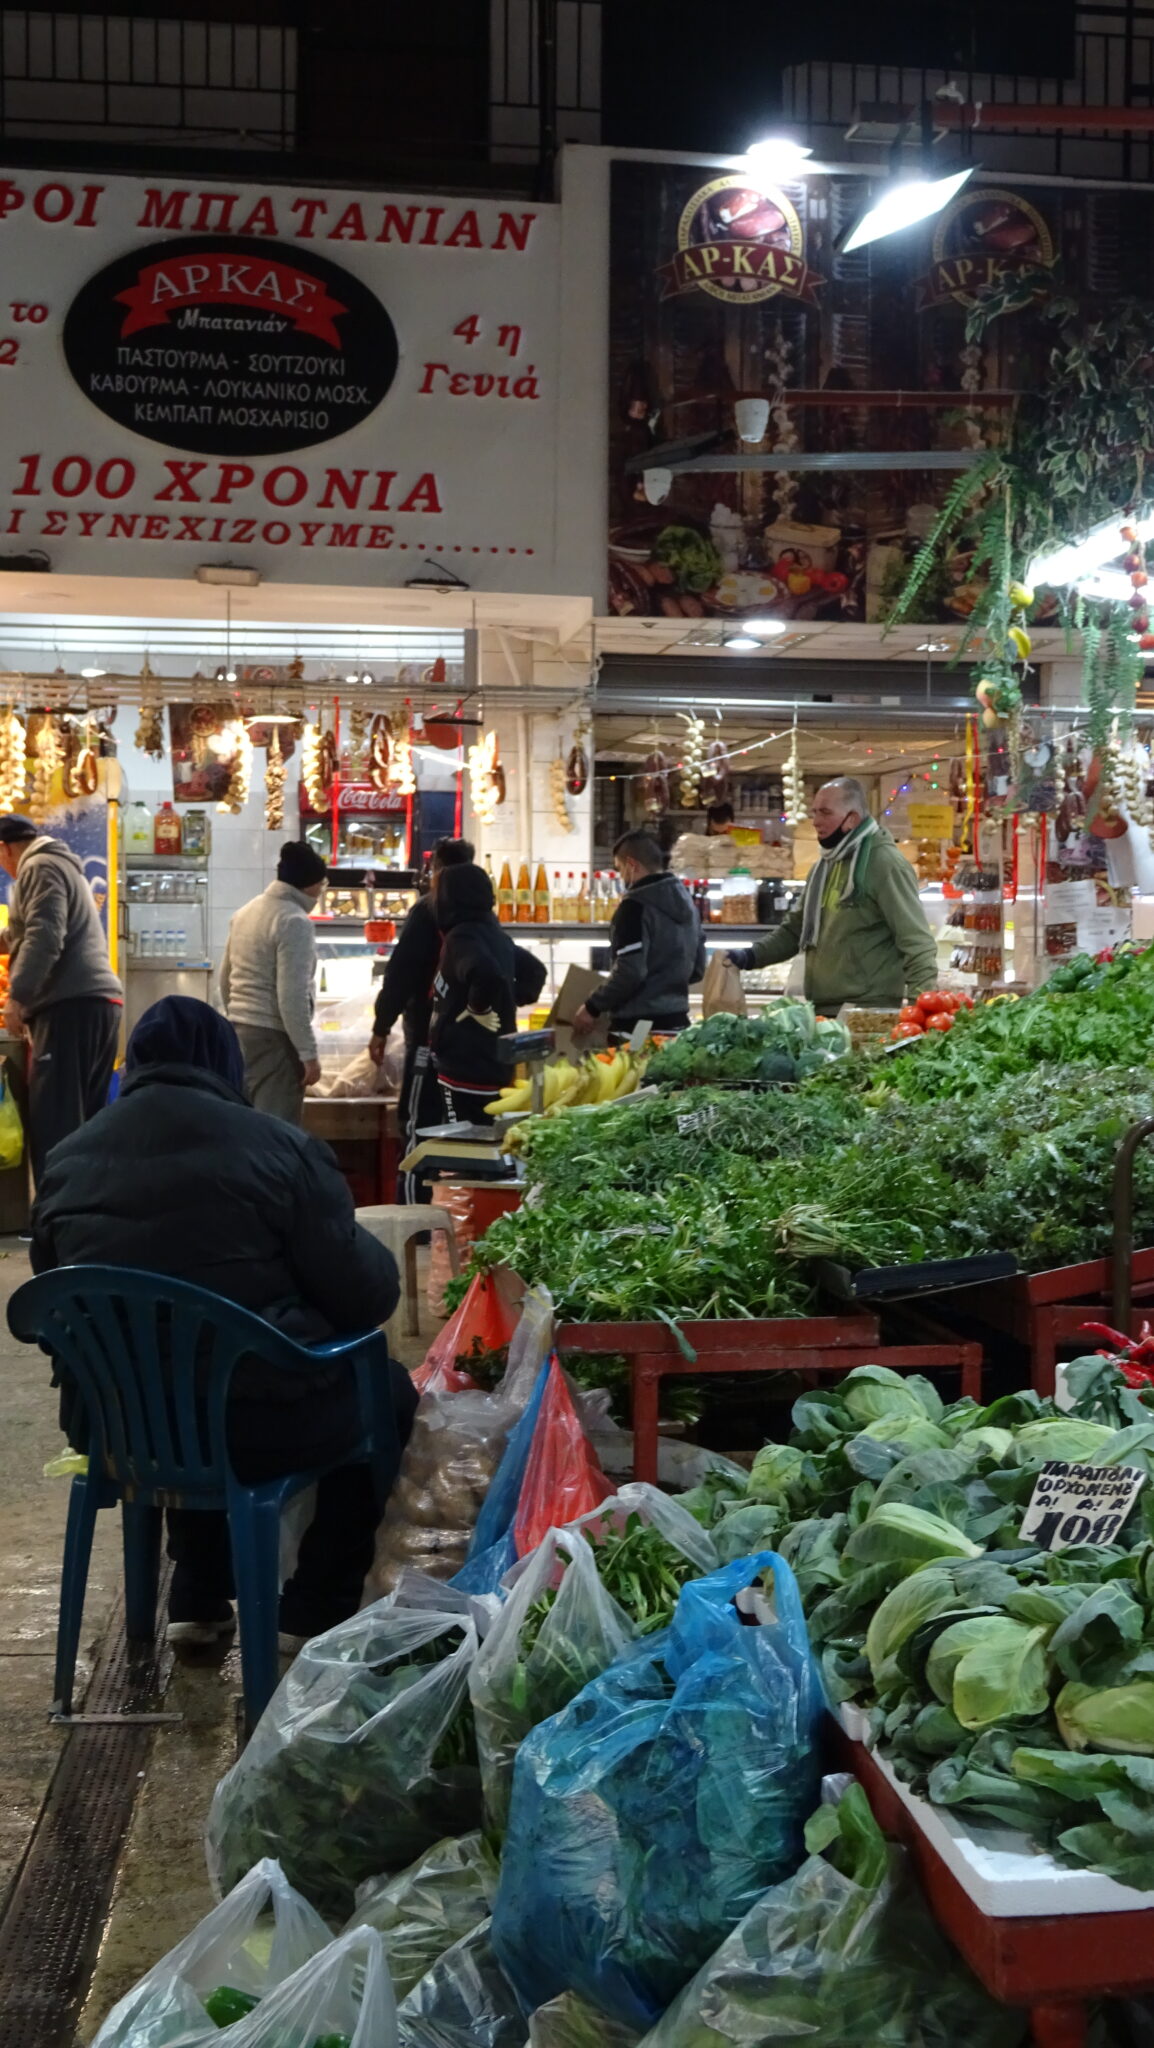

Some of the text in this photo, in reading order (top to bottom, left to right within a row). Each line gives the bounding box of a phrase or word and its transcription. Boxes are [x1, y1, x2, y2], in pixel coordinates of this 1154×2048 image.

[138, 189, 536, 251] ΜΠΑΤΑΝΙΑΝ
[683, 245, 802, 285] ΑΡ-ΚΑΣ
[150, 263, 317, 313] ΑΡΚΑΣ
[10, 303, 49, 324] το
[177, 308, 288, 332] Μπατανιάν
[454, 315, 522, 357] 4 η
[117, 347, 229, 371] ΠΑΣΤΟΥΡΜΑ
[248, 353, 346, 376] ΣΟΥΤΖΟΥΚΙ
[90, 373, 189, 395] ΚΑΒΟΥΡΜΑ
[203, 379, 310, 402] ΛΟΥΚΑΝΙΚΟ
[315, 385, 372, 404] ΜΟΣΧ.
[419, 363, 540, 400] Γενιά
[134, 403, 330, 430] ΚΕΜΠΑΠ ΜΟΣΧΑΡΙΣΙΟ
[11, 454, 442, 513] 100 ΧΡΟΝΙΑ
